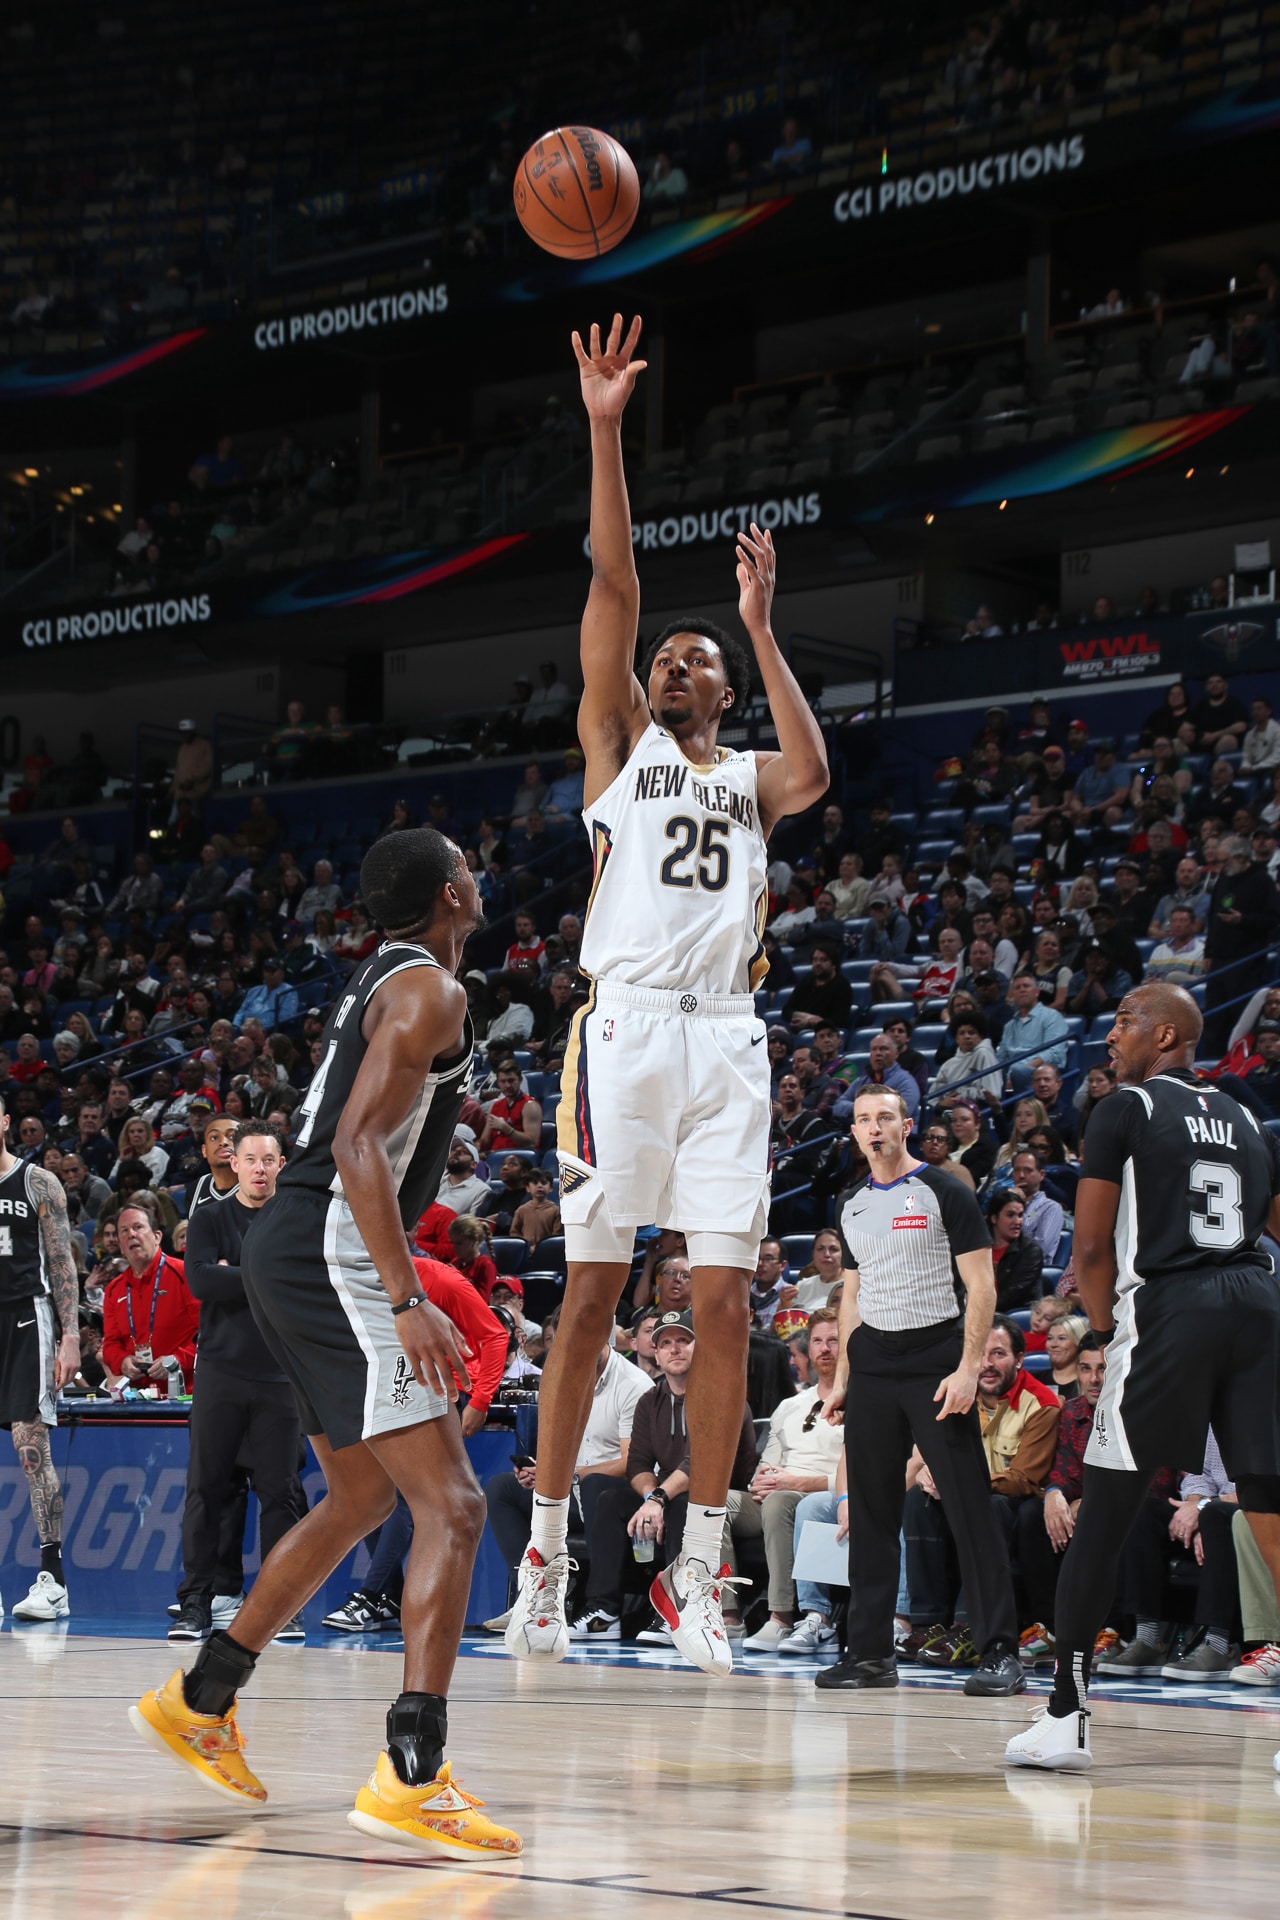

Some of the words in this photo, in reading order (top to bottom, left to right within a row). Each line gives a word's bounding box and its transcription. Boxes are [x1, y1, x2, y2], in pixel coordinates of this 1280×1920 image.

[834, 186, 872, 222] CCI
[879, 133, 1085, 213] PRODUCTIONS
[254, 319, 284, 349] CCI
[289, 284, 449, 342] PRODUCTIONS
[22, 620, 51, 647] CCI
[57, 594, 211, 642] PRODUCTIONS
[1060, 632, 1161, 663] WWL
[634, 765, 689, 802] NEW
[692, 779, 754, 831] RLENS
[660, 814, 731, 893] 25
[295, 1039, 339, 1148] 4
[1184, 1115, 1238, 1150] PAUL
[893, 1218, 927, 1228] Emirates
[1189, 1159, 1245, 1249] 3
